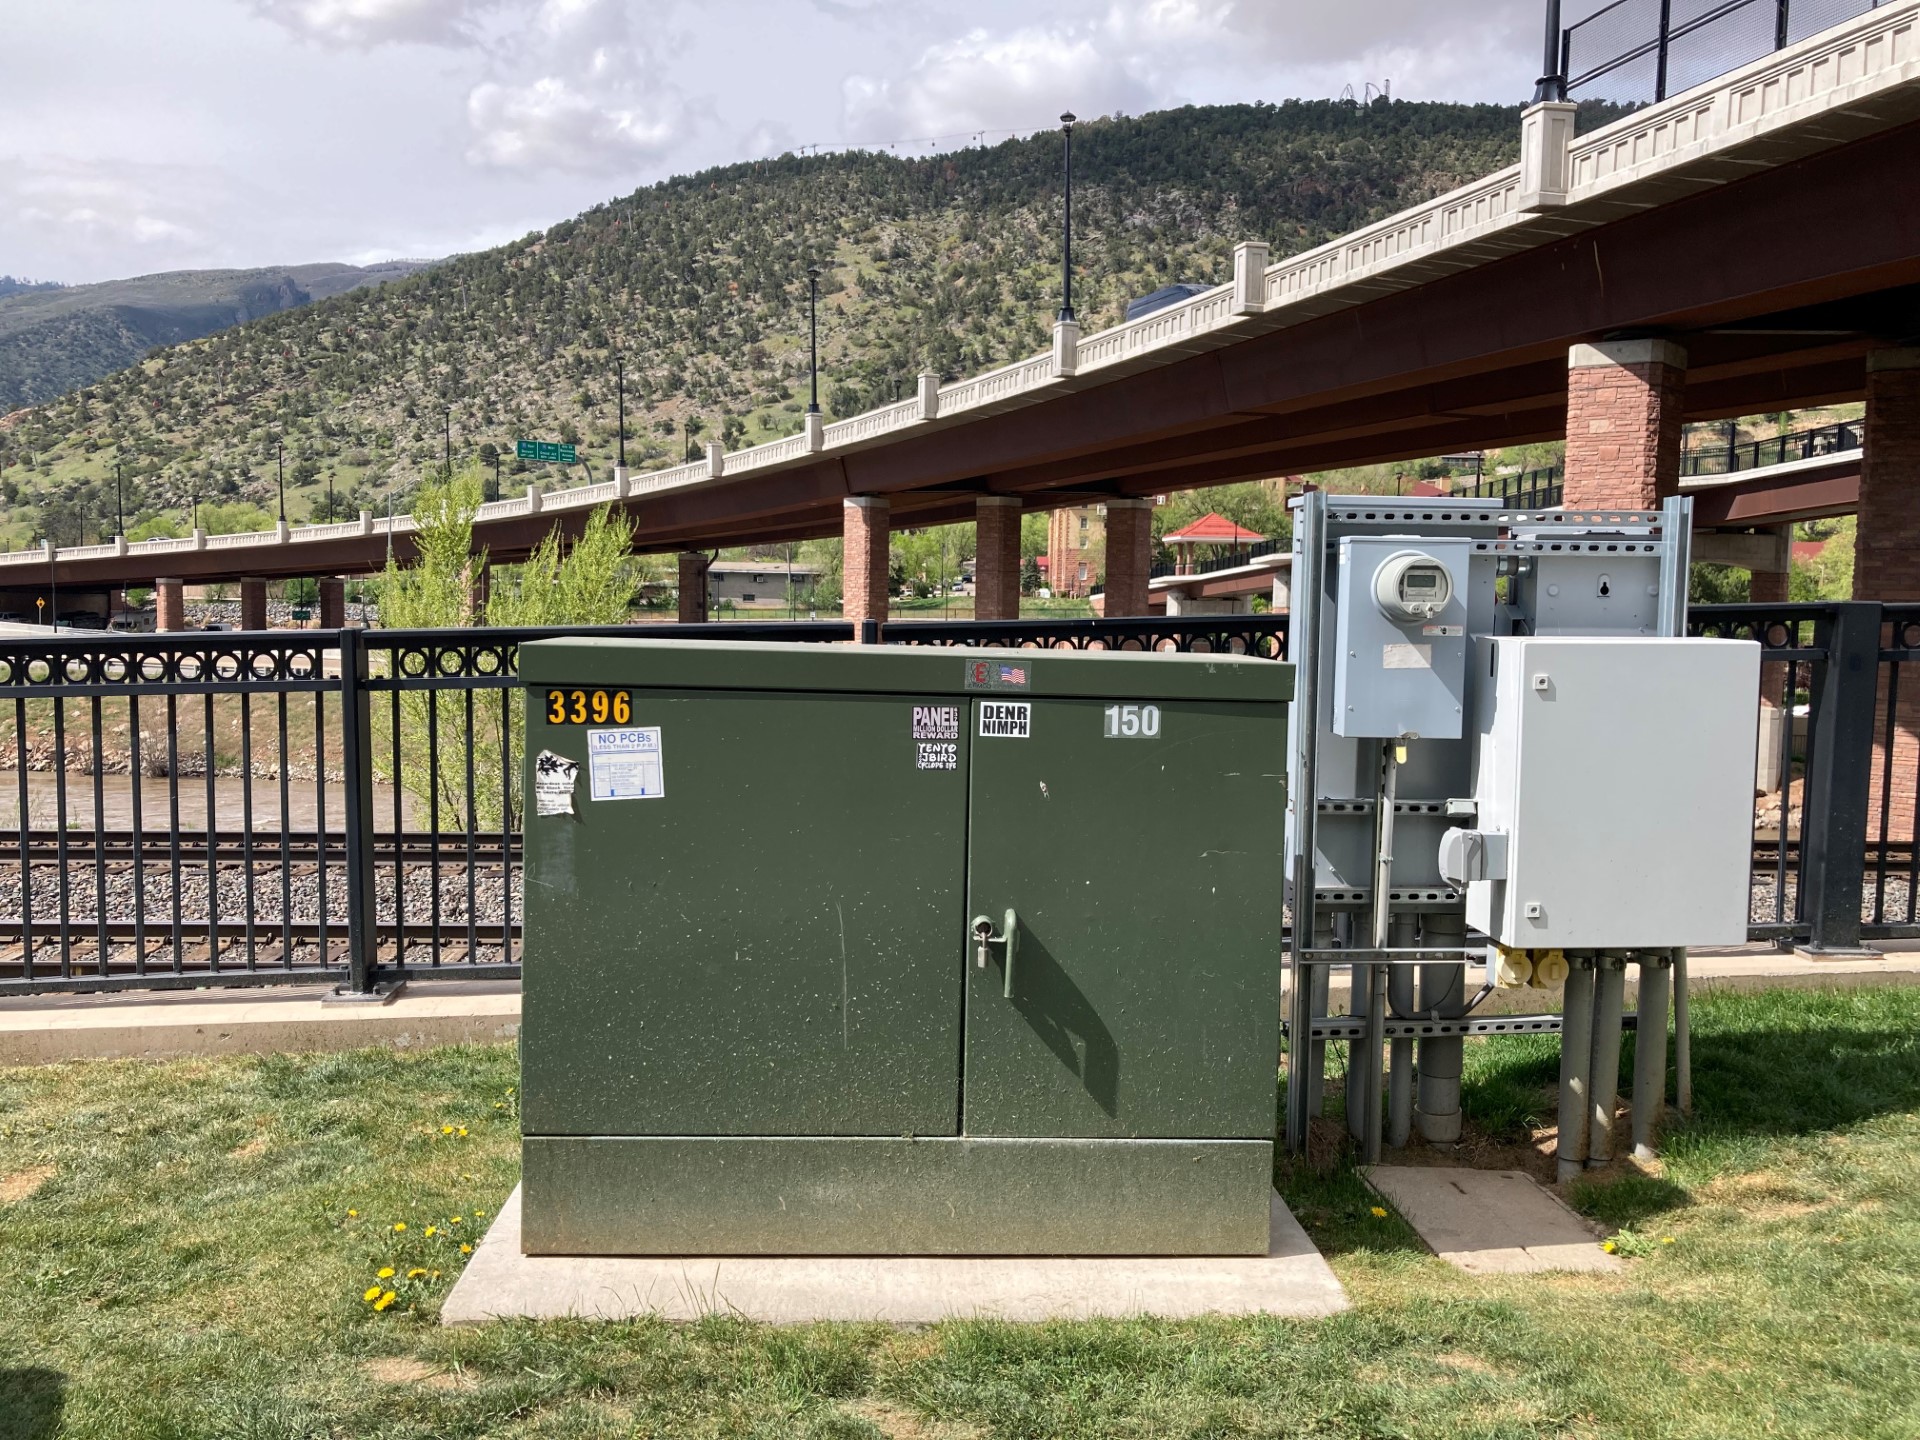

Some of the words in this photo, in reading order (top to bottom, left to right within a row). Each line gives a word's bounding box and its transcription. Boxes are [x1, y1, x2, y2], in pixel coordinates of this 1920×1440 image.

[548, 690, 630, 724] 3396
[983, 705, 1028, 721] DENR
[913, 707, 958, 726] PANEL
[1105, 705, 1159, 736] 150
[913, 731, 958, 739] REWARD
[982, 719, 1027, 735] NIMPH
[598, 734, 616, 744] NO
[620, 733, 652, 743] PCBs
[922, 752, 957, 762] JBIRD
